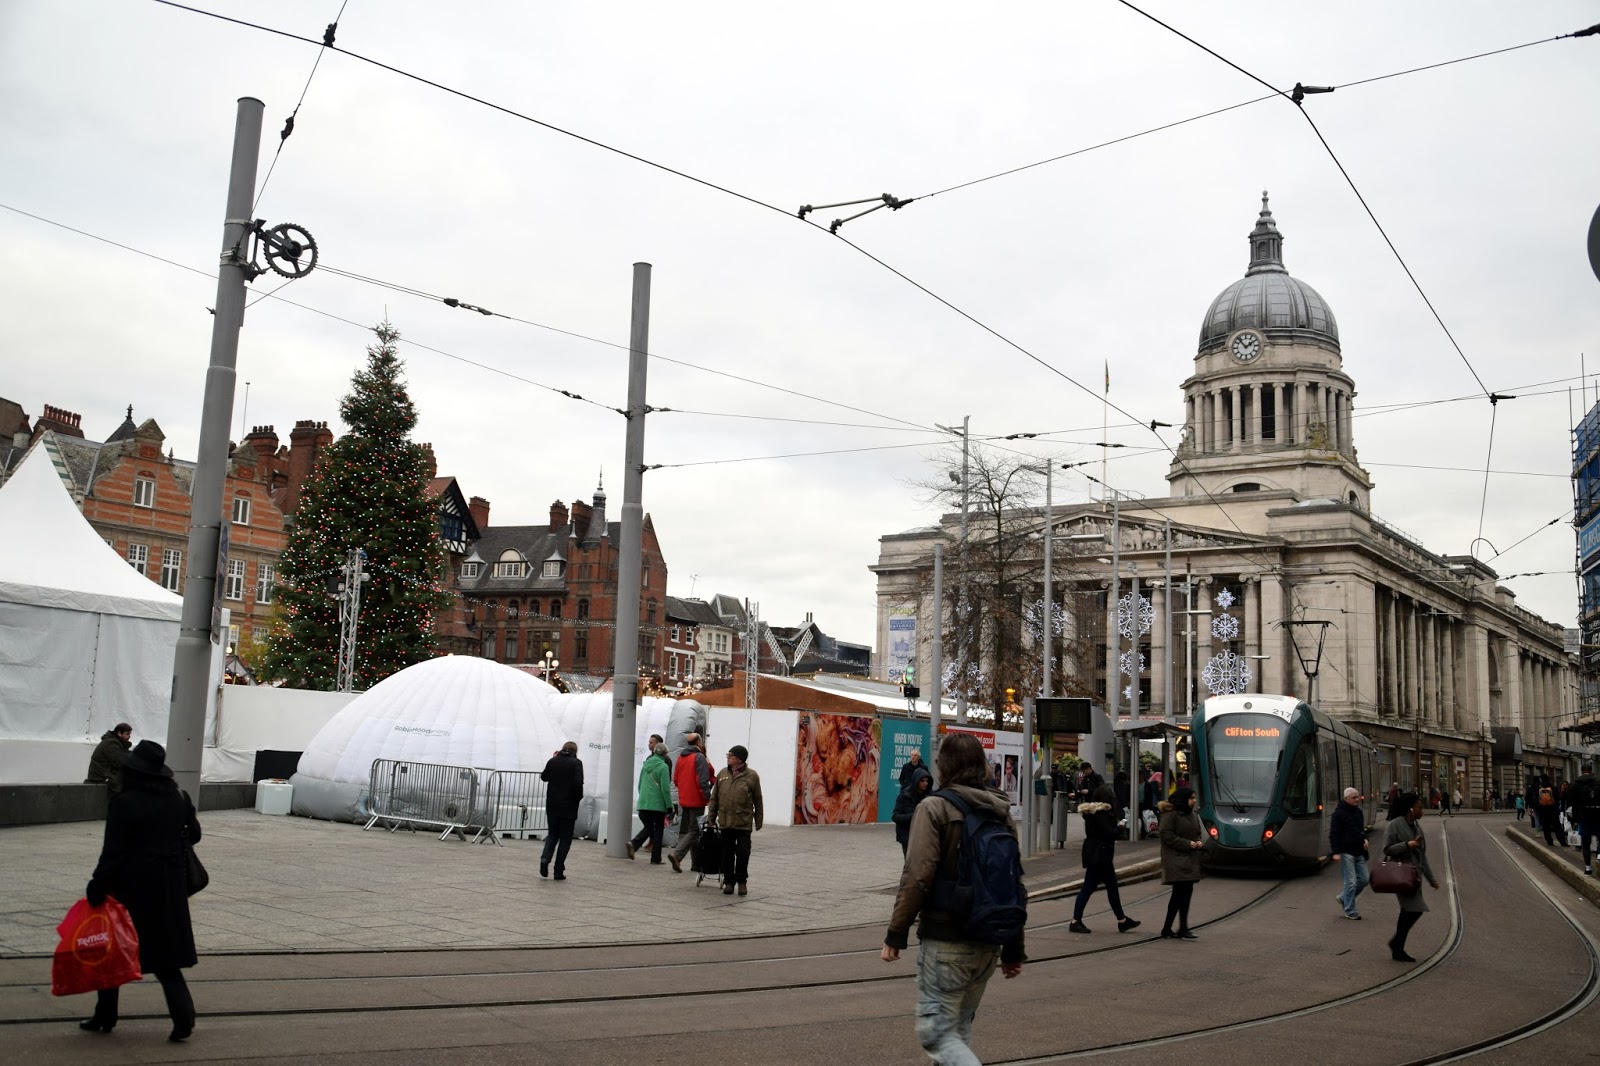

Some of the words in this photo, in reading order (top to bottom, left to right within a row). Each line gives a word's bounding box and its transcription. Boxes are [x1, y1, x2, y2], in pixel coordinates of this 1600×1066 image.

[1272, 708, 1292, 718] 217
[1225, 727, 1253, 736] Clifton
[1255, 728, 1280, 737] South
[894, 733, 906, 744] WHEN
[907, 734, 922, 745] YOU'RE
[982, 735, 994, 747] good
[895, 745, 903, 756] THE
